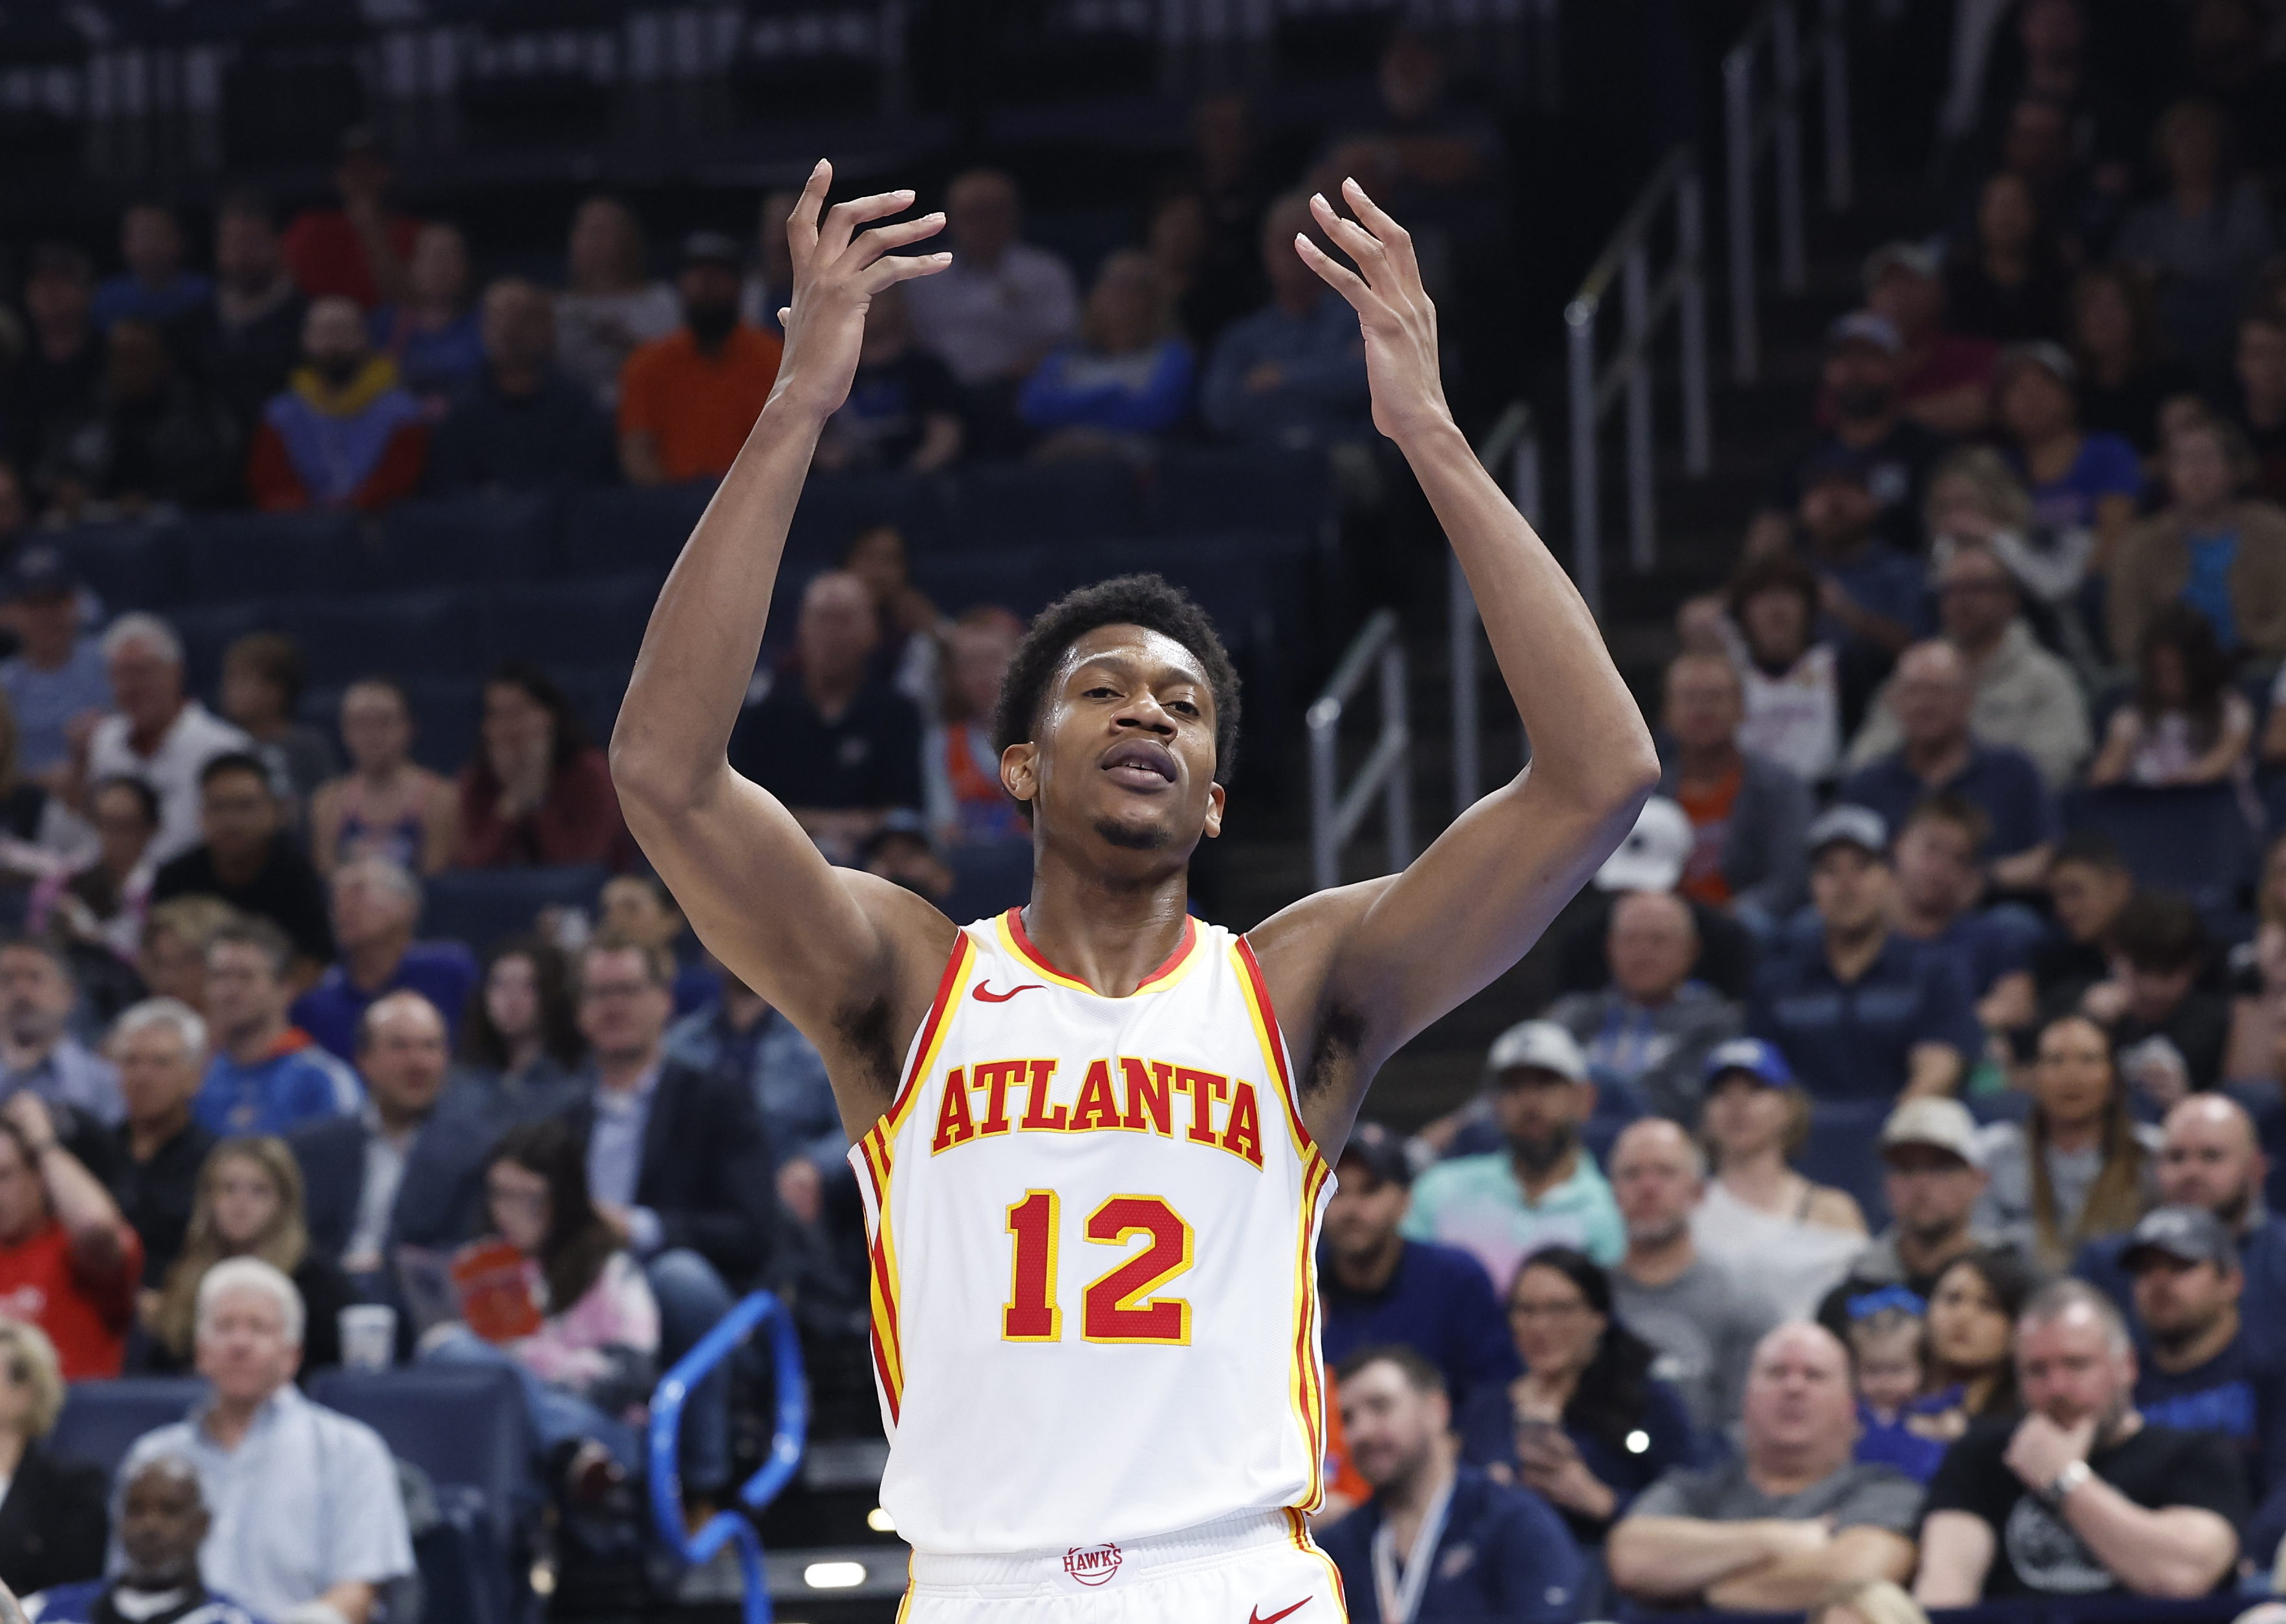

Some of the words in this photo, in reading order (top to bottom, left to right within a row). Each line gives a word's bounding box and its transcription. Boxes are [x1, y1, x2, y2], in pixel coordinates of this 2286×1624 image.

[931, 1055, 1264, 1173] ATLANTA
[1000, 1188, 1194, 1346] 12
[1062, 1548, 1123, 1572] HAWKS
